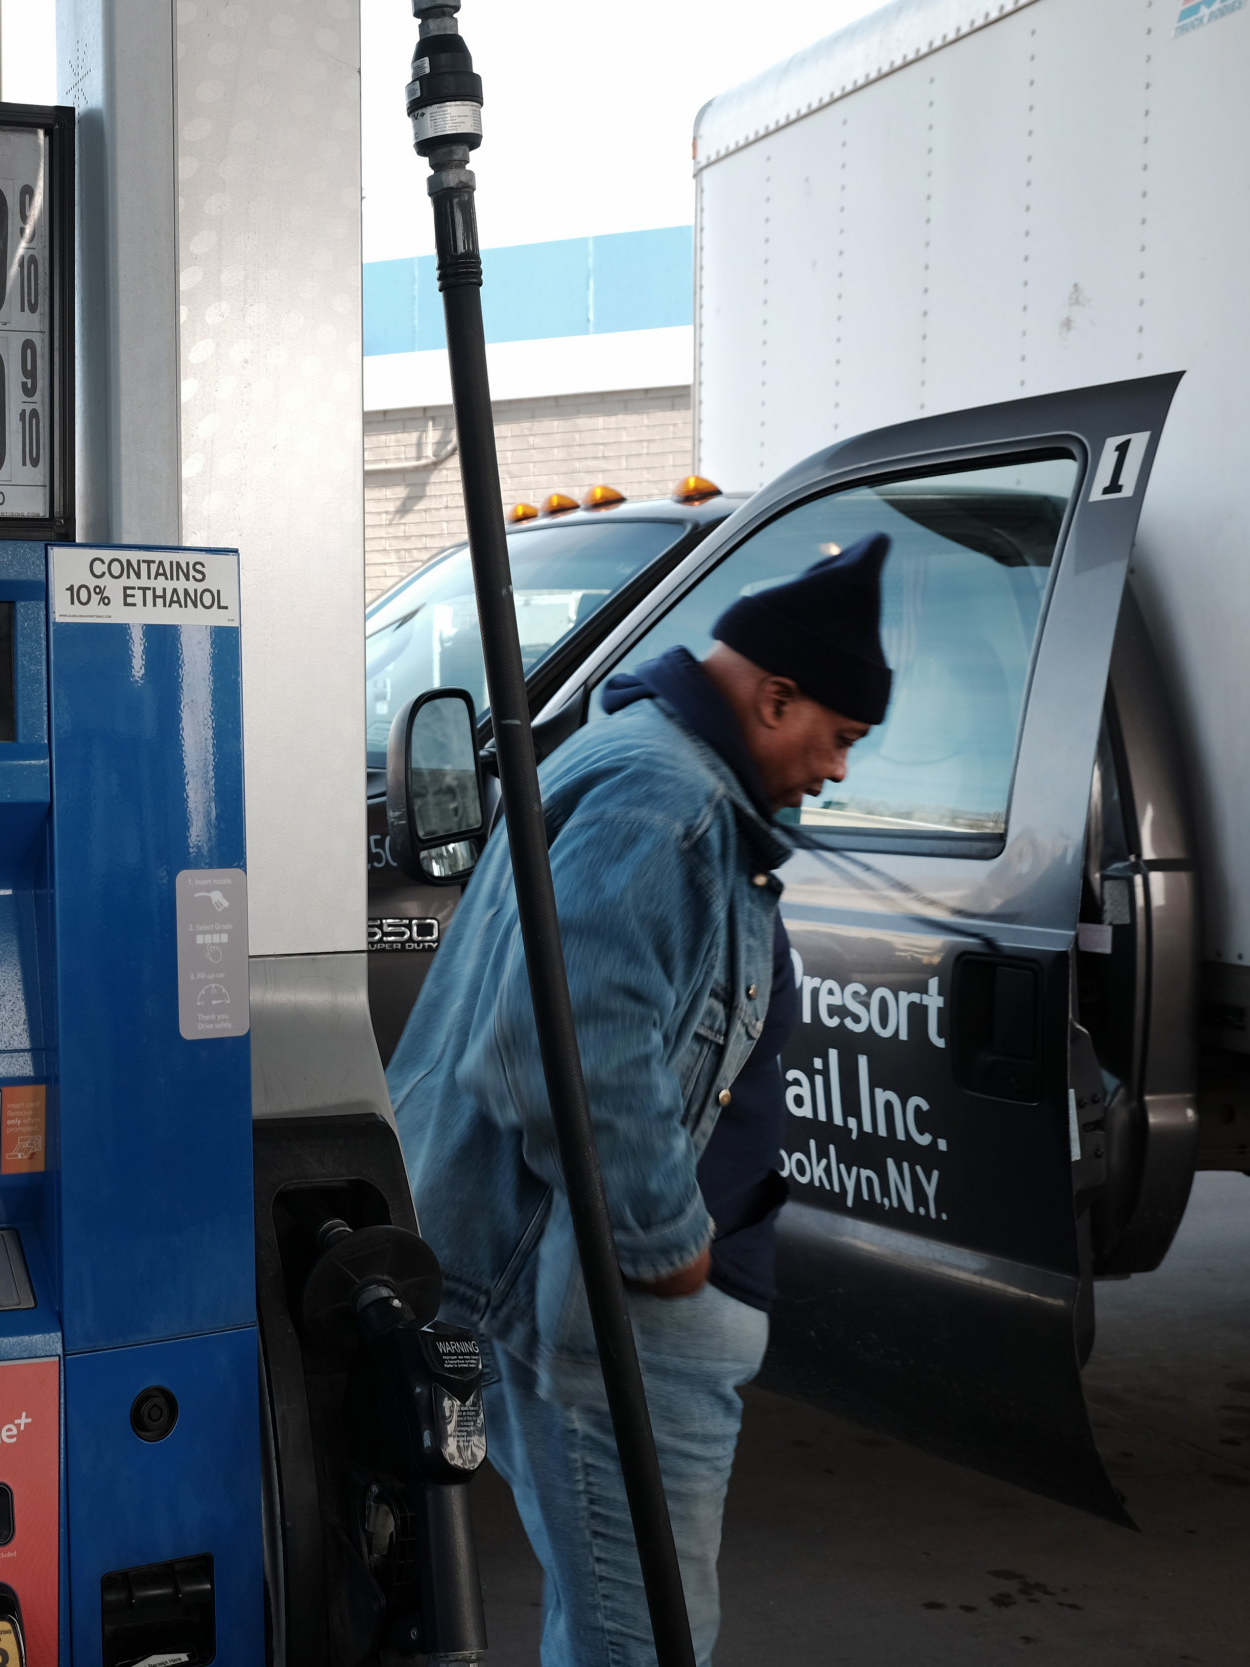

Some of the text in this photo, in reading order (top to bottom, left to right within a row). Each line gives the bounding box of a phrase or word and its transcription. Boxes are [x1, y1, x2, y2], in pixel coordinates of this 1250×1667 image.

[1101, 437, 1132, 496] 1
[89, 556, 206, 582] CONTAINS
[65, 584, 229, 610] 10% ETHANOL
[368, 942, 438, 950] UPER DUTY
[777, 1048, 948, 1151] ail,Inc.
[7, 1118, 21, 1126] only
[778, 1138, 948, 1221] ooklyn,N.Y.
[436, 1340, 480, 1354] WARNING
